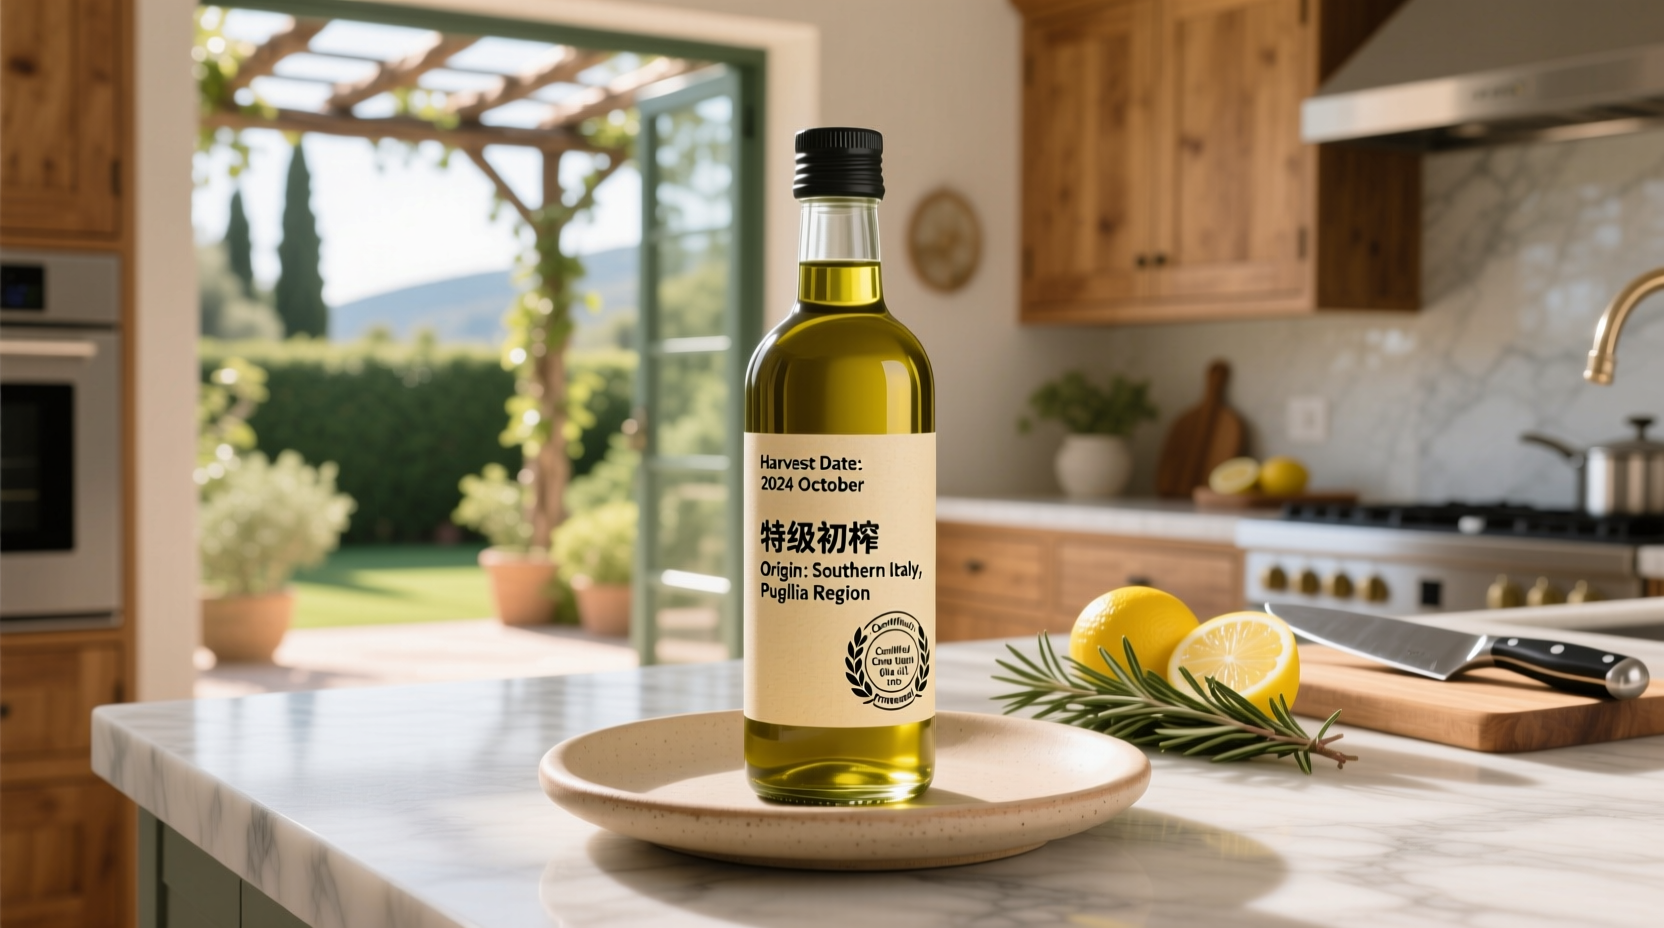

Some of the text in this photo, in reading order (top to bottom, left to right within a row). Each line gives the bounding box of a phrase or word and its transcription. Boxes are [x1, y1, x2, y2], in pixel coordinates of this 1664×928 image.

[760, 454, 863, 471] Harvest Date:
[760, 475, 865, 493] 2024 October
[760, 518, 880, 555] 特级初榨
[760, 560, 923, 582] Origin: Southern Italy,
[760, 581, 871, 605] Pugllia Region
